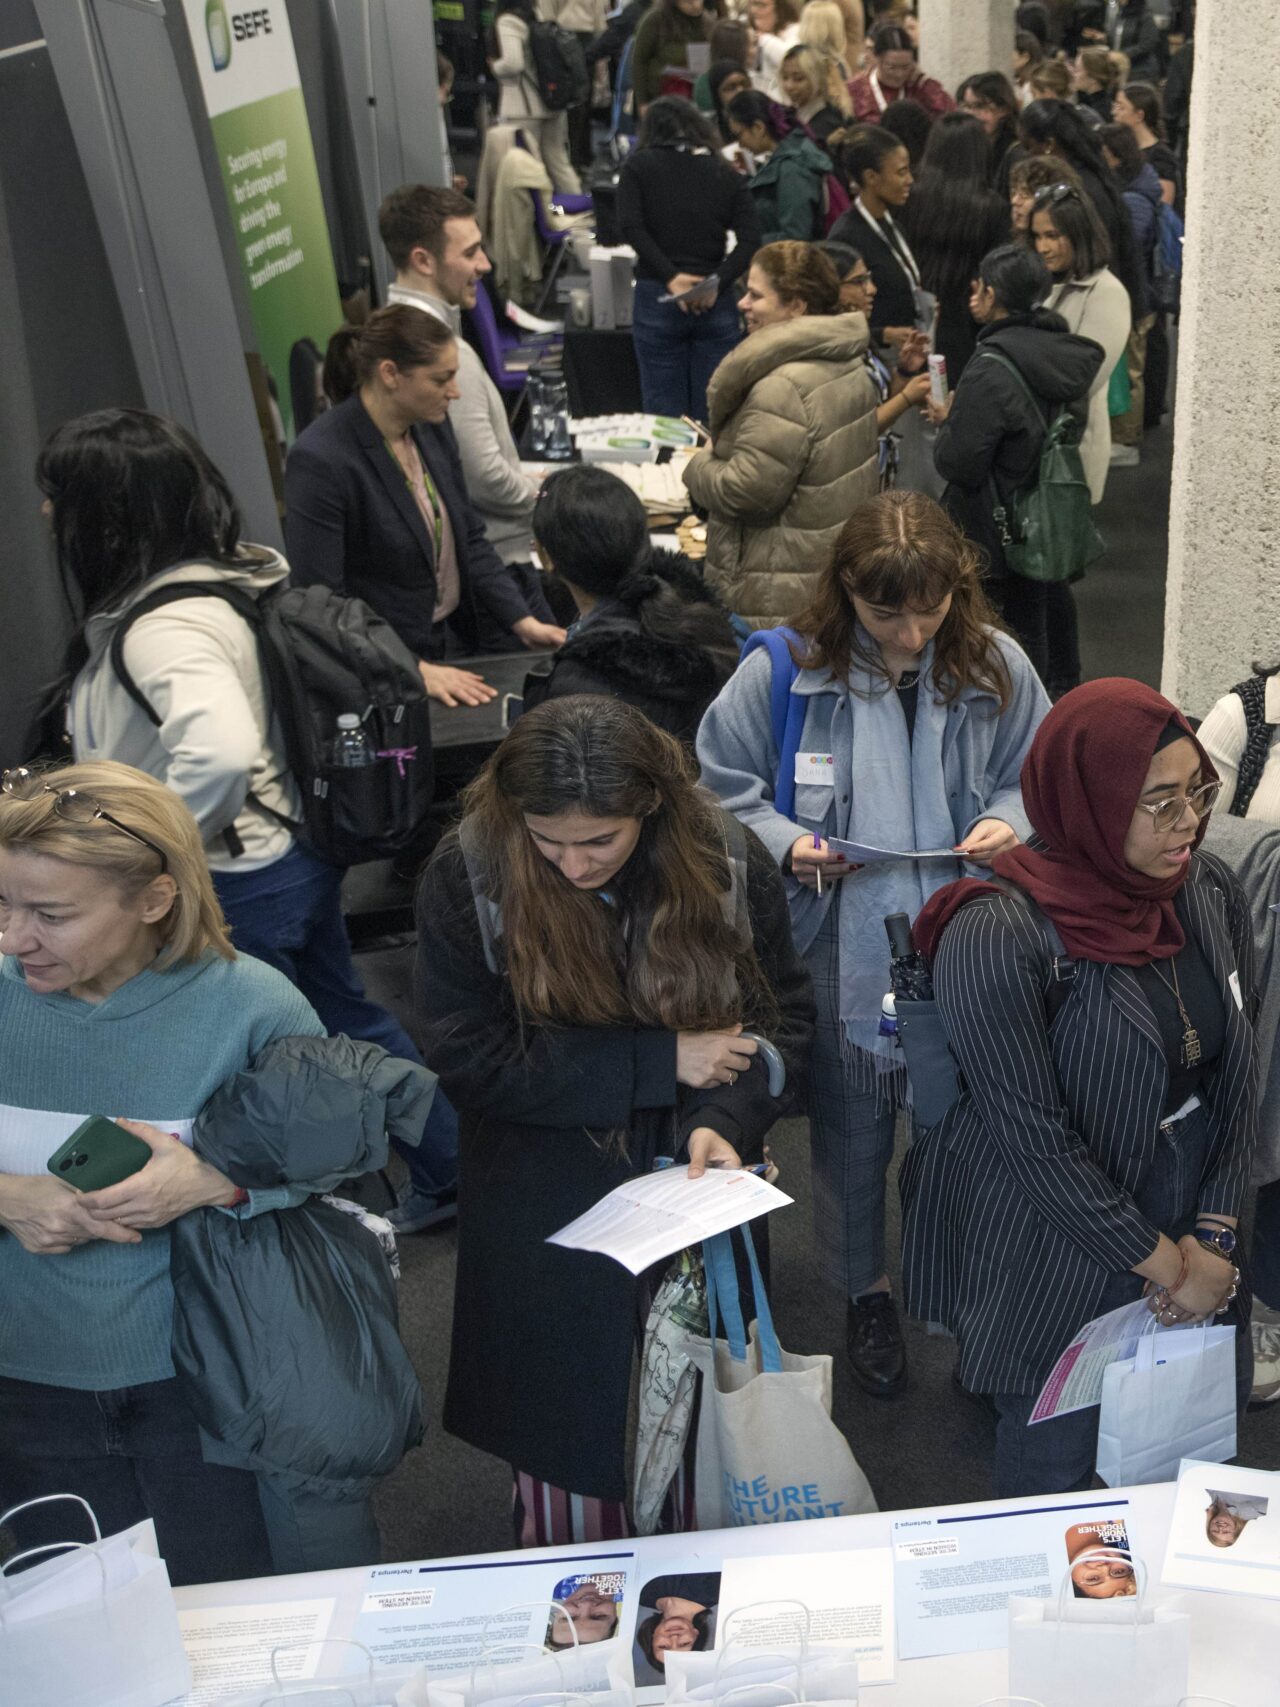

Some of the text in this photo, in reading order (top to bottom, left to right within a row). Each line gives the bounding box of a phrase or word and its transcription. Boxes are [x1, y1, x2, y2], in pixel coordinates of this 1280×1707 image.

[232, 8, 272, 42] SEFE
[227, 146, 262, 176] Securing
[265, 199, 282, 219] the
[729, 1484, 822, 1518] UTURE
[1077, 1522, 1125, 1534] TOGETHER
[1098, 1529, 1127, 1538] WORK
[1102, 1535, 1128, 1544] LET'S
[575, 1574, 626, 1585] TOGETHER
[595, 1580, 625, 1590] WORK
[598, 1588, 625, 1596] LET'S
